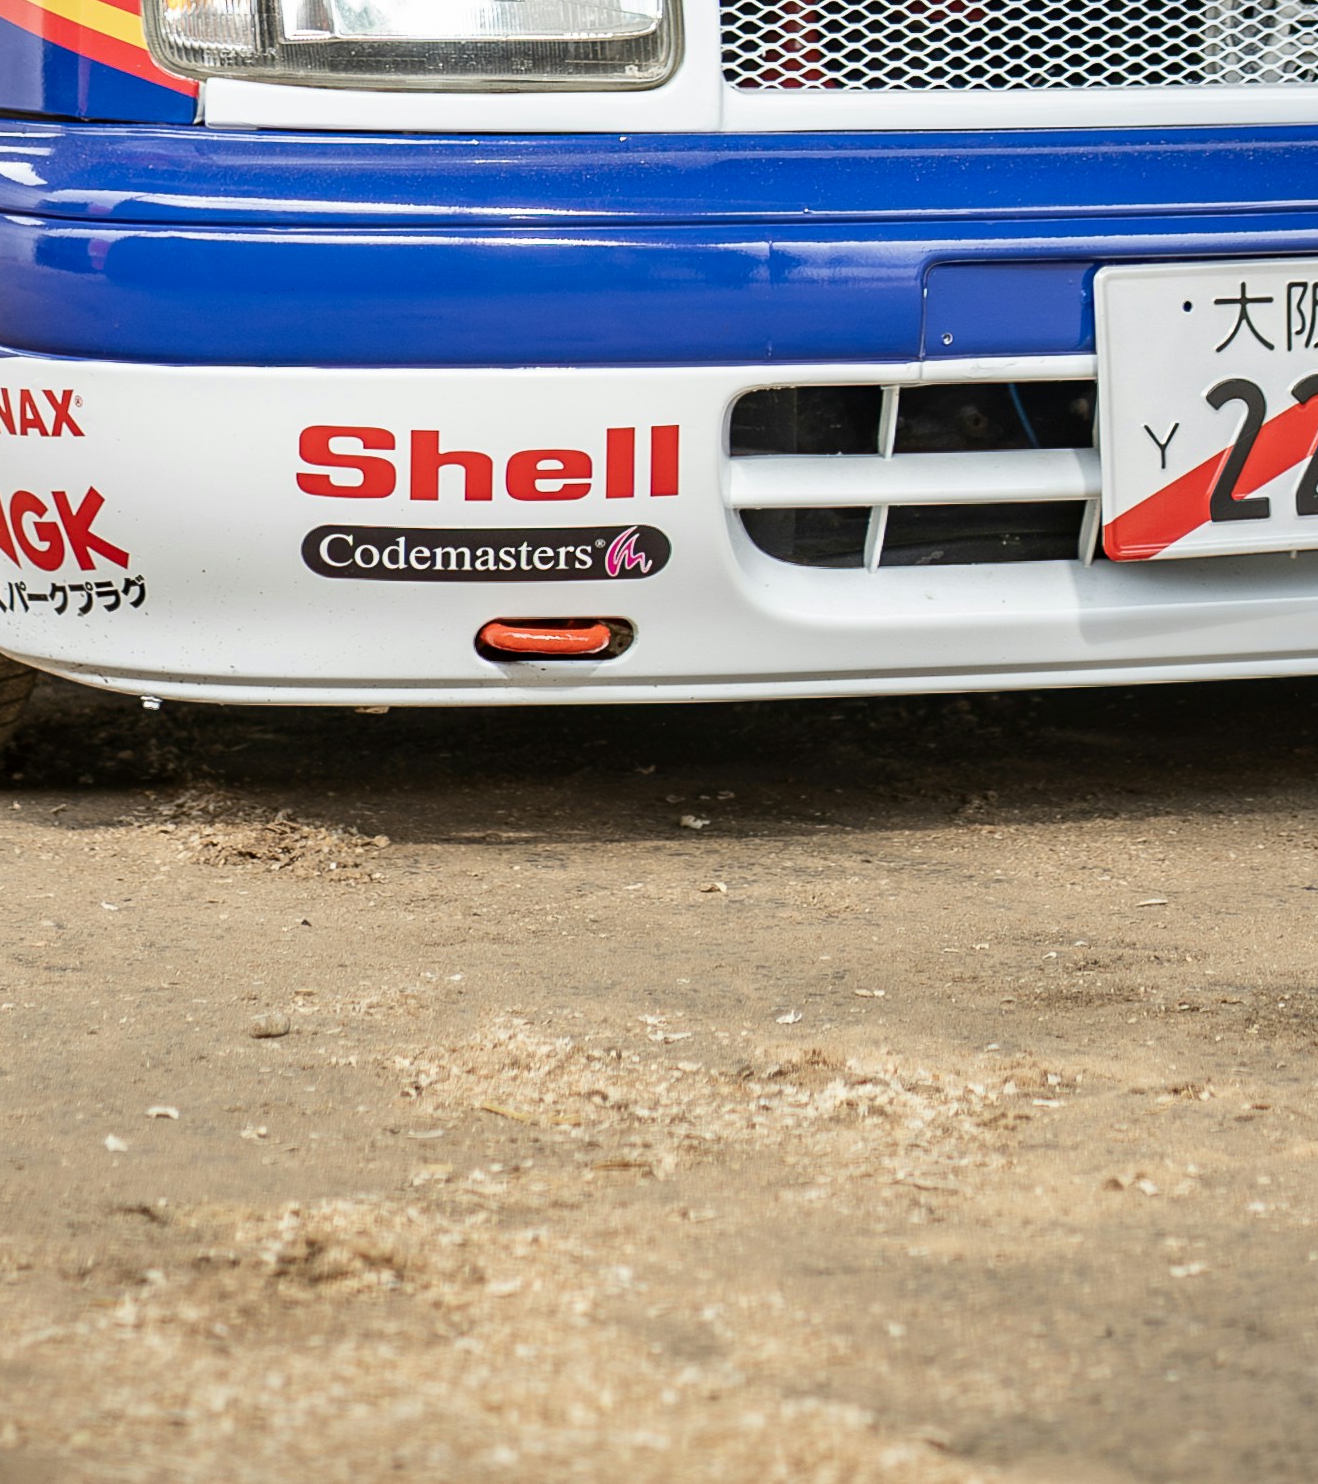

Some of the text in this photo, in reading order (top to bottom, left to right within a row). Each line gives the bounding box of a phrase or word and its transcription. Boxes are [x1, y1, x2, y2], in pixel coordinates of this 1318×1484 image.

[296, 424, 681, 502] Shell
[1143, 421, 1180, 470] Y
[318, 534, 596, 574] Codemasters
